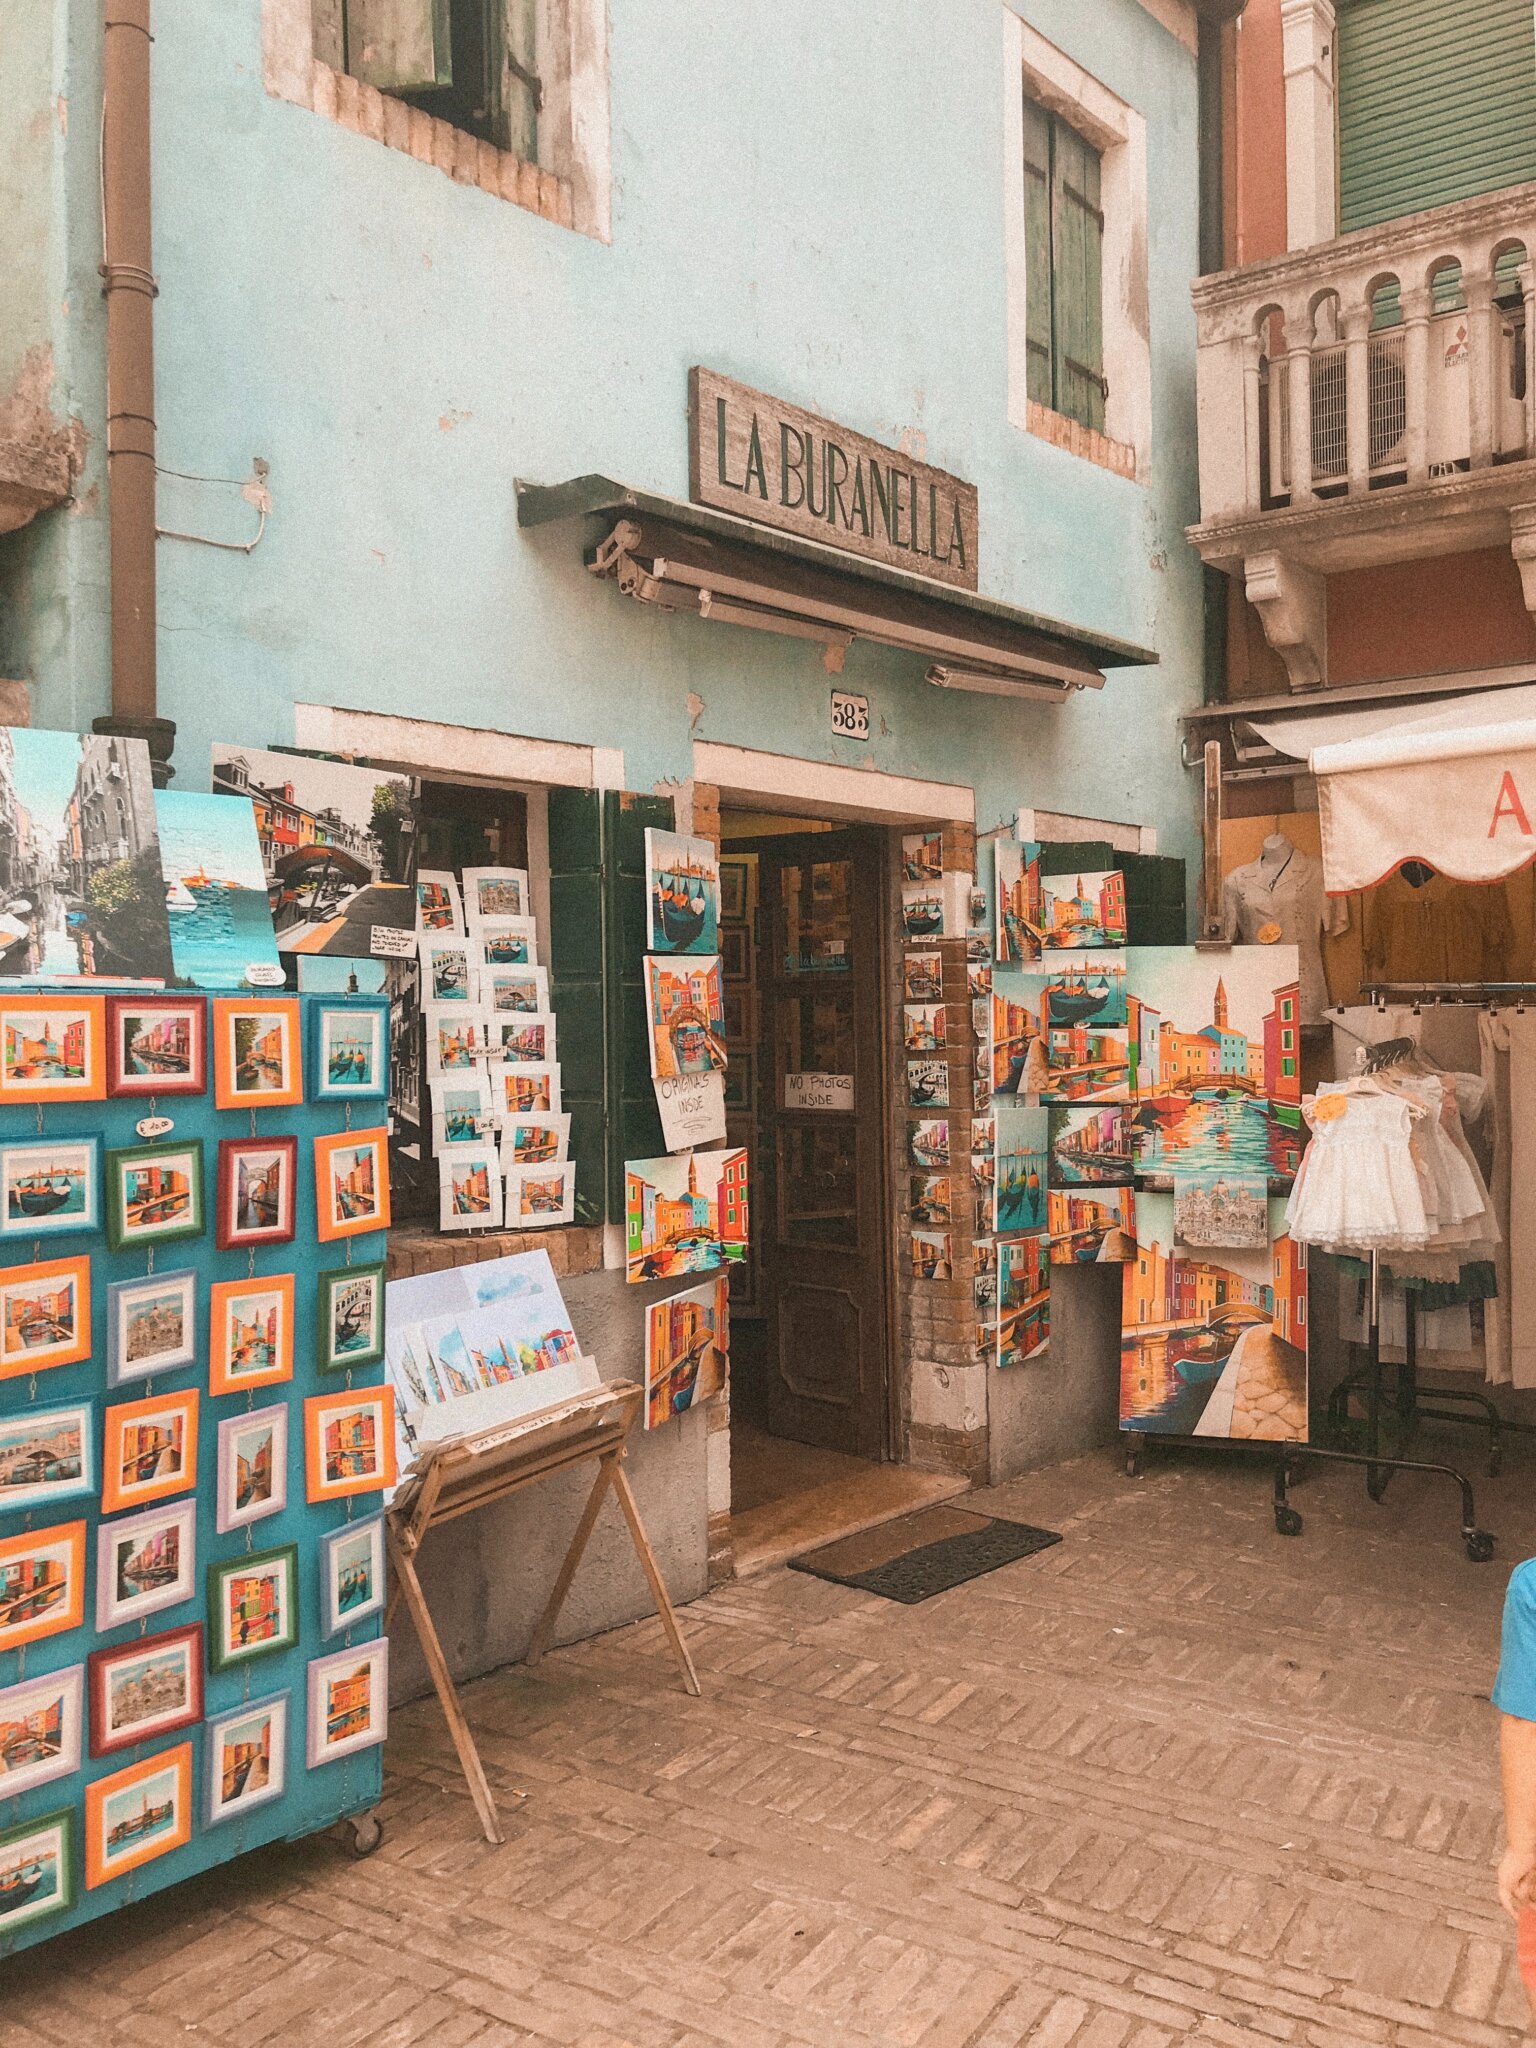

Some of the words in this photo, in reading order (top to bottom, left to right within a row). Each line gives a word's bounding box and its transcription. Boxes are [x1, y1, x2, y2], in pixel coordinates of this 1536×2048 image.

[716, 396, 769, 501] LA
[779, 421, 966, 570] BURANELLA
[833, 701, 869, 731] 383
[1487, 770, 1533, 839] A
[790, 1076, 803, 1089] NO
[810, 1076, 851, 1090] PHOTOS
